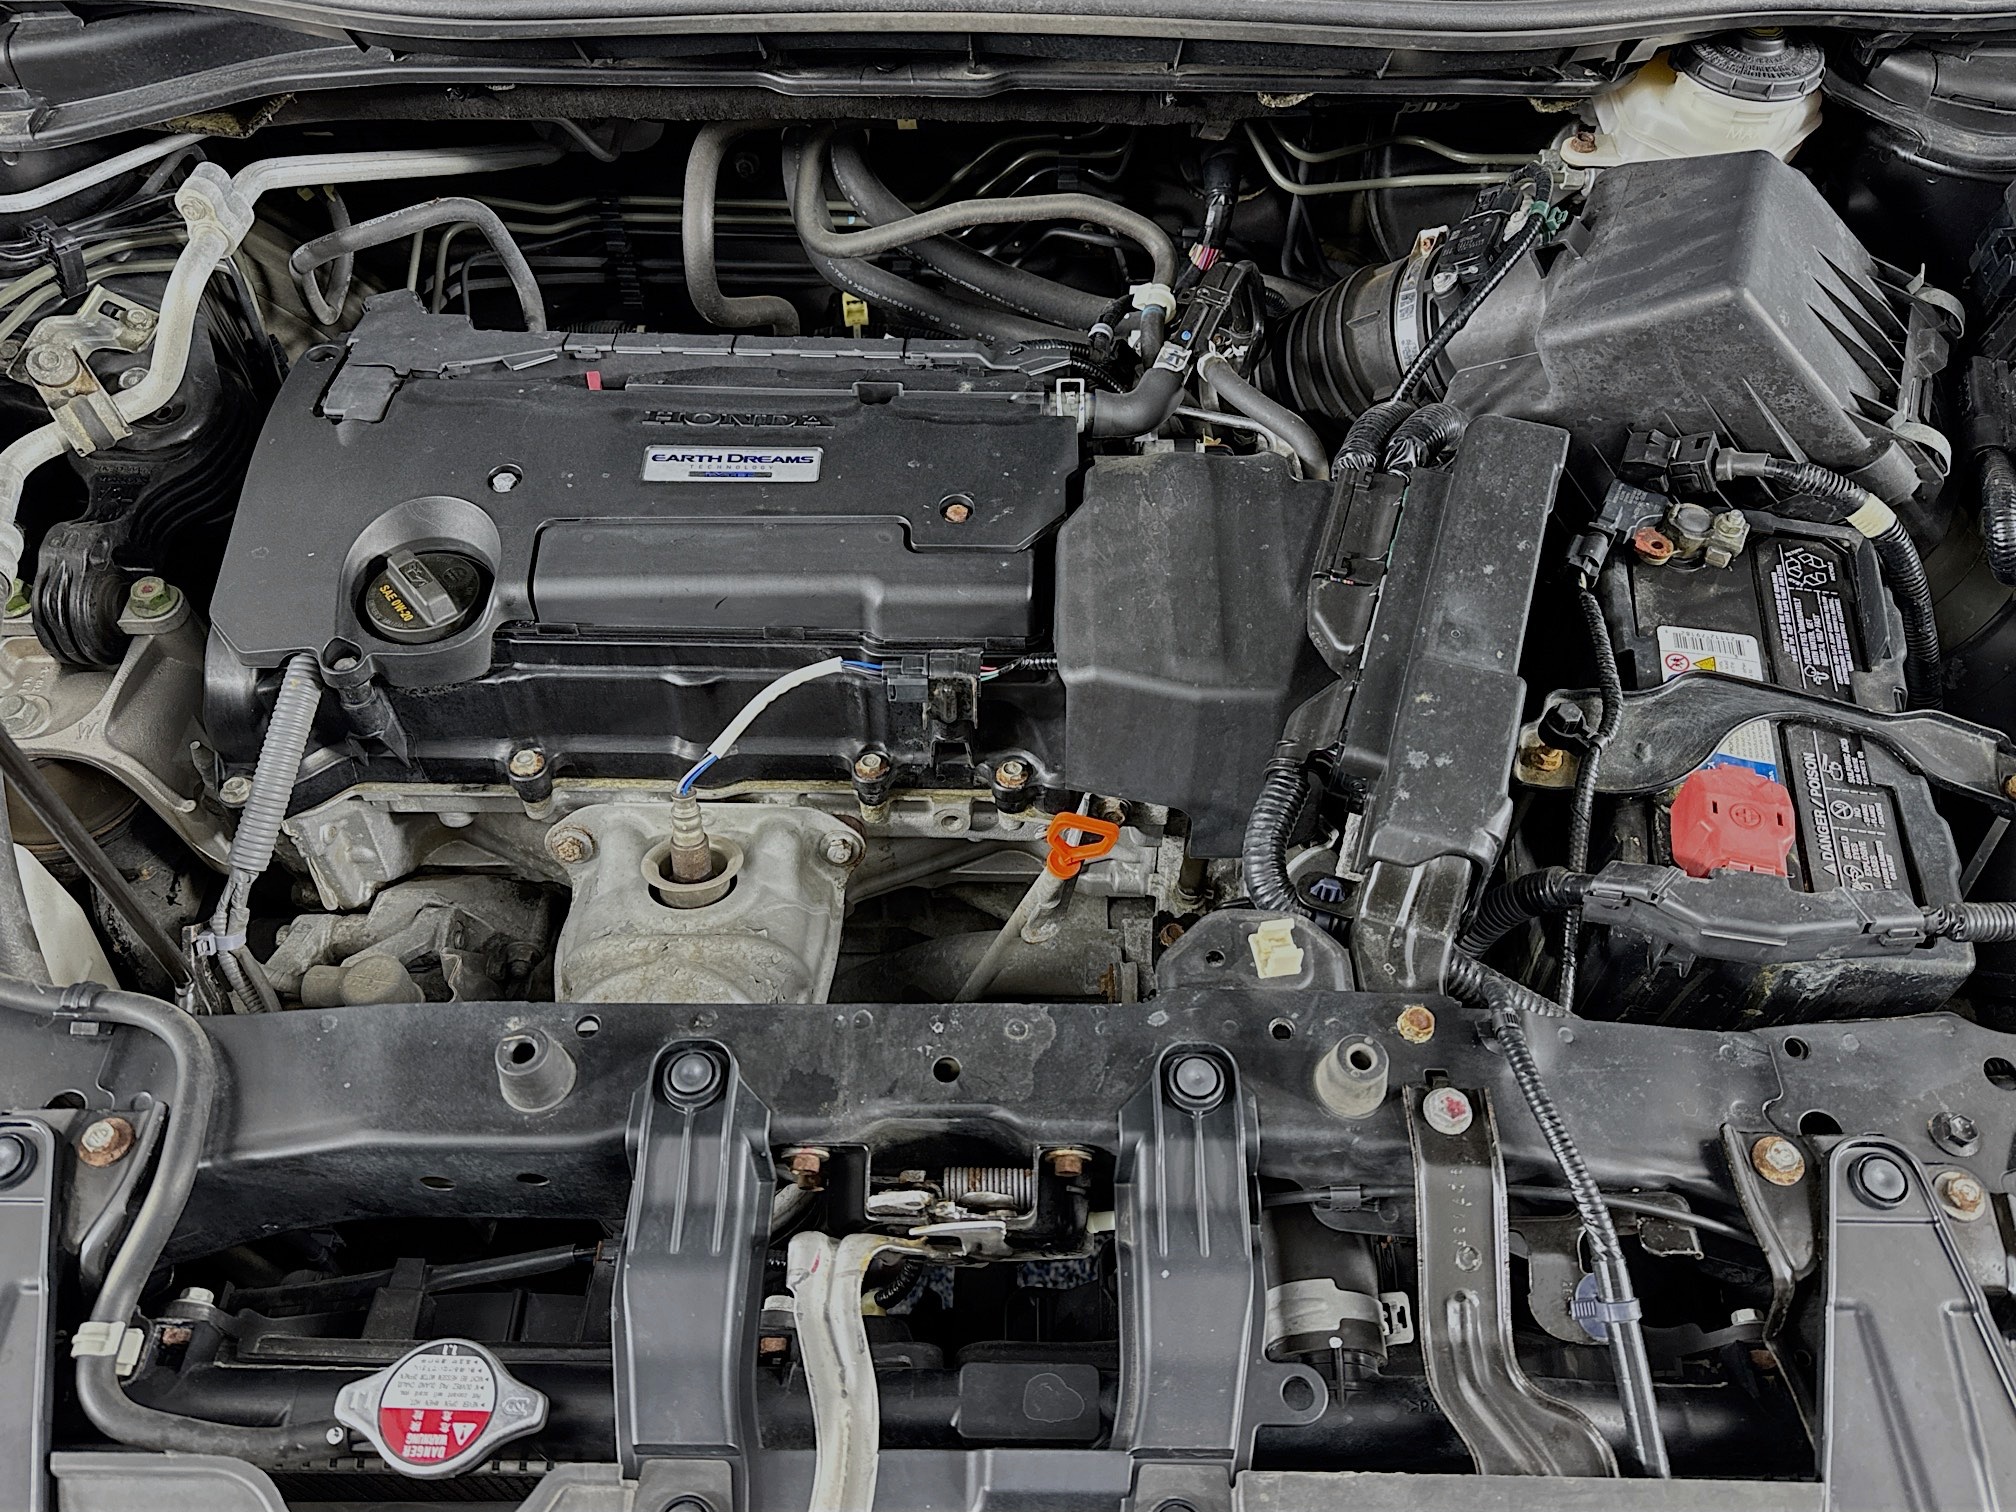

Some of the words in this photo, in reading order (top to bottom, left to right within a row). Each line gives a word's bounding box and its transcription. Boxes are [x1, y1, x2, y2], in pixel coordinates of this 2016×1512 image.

[642, 410, 836, 429] HONDA
[651, 454, 723, 464] EARTH
[727, 453, 814, 464] DREAMS
[1827, 561, 1835, 581] RECYCLE
[380, 585, 398, 602] SAE
[391, 599, 414, 622] 0W-20
[1792, 597, 1806, 632] IMMEDIATELY
[1805, 618, 1814, 629] GET
[1812, 613, 1822, 627] FAST
[1799, 632, 1808, 645] EYES
[1815, 628, 1824, 642] HELP
[1801, 645, 1812, 664] FLUSH
[1810, 649, 1820, 665] WITH
[1817, 642, 1828, 666] MEDICAL
[1839, 737, 1849, 753] ACID
[1802, 752, 1822, 797] POISON
[1843, 753, 1855, 783] SULFURIC
[1853, 807, 1861, 818] NO
[1813, 808, 1834, 861] DANGER
[1840, 835, 1852, 859] SHIELD
[1850, 842, 1860, 860] EYES
[1858, 840, 1872, 876] EXPLOSIVE
[1869, 854, 1881, 877] GASES
[441, 1344, 457, 1354] 1.1
[405, 1432, 447, 1444] WARNING
[402, 1445, 445, 1458] DANGER
